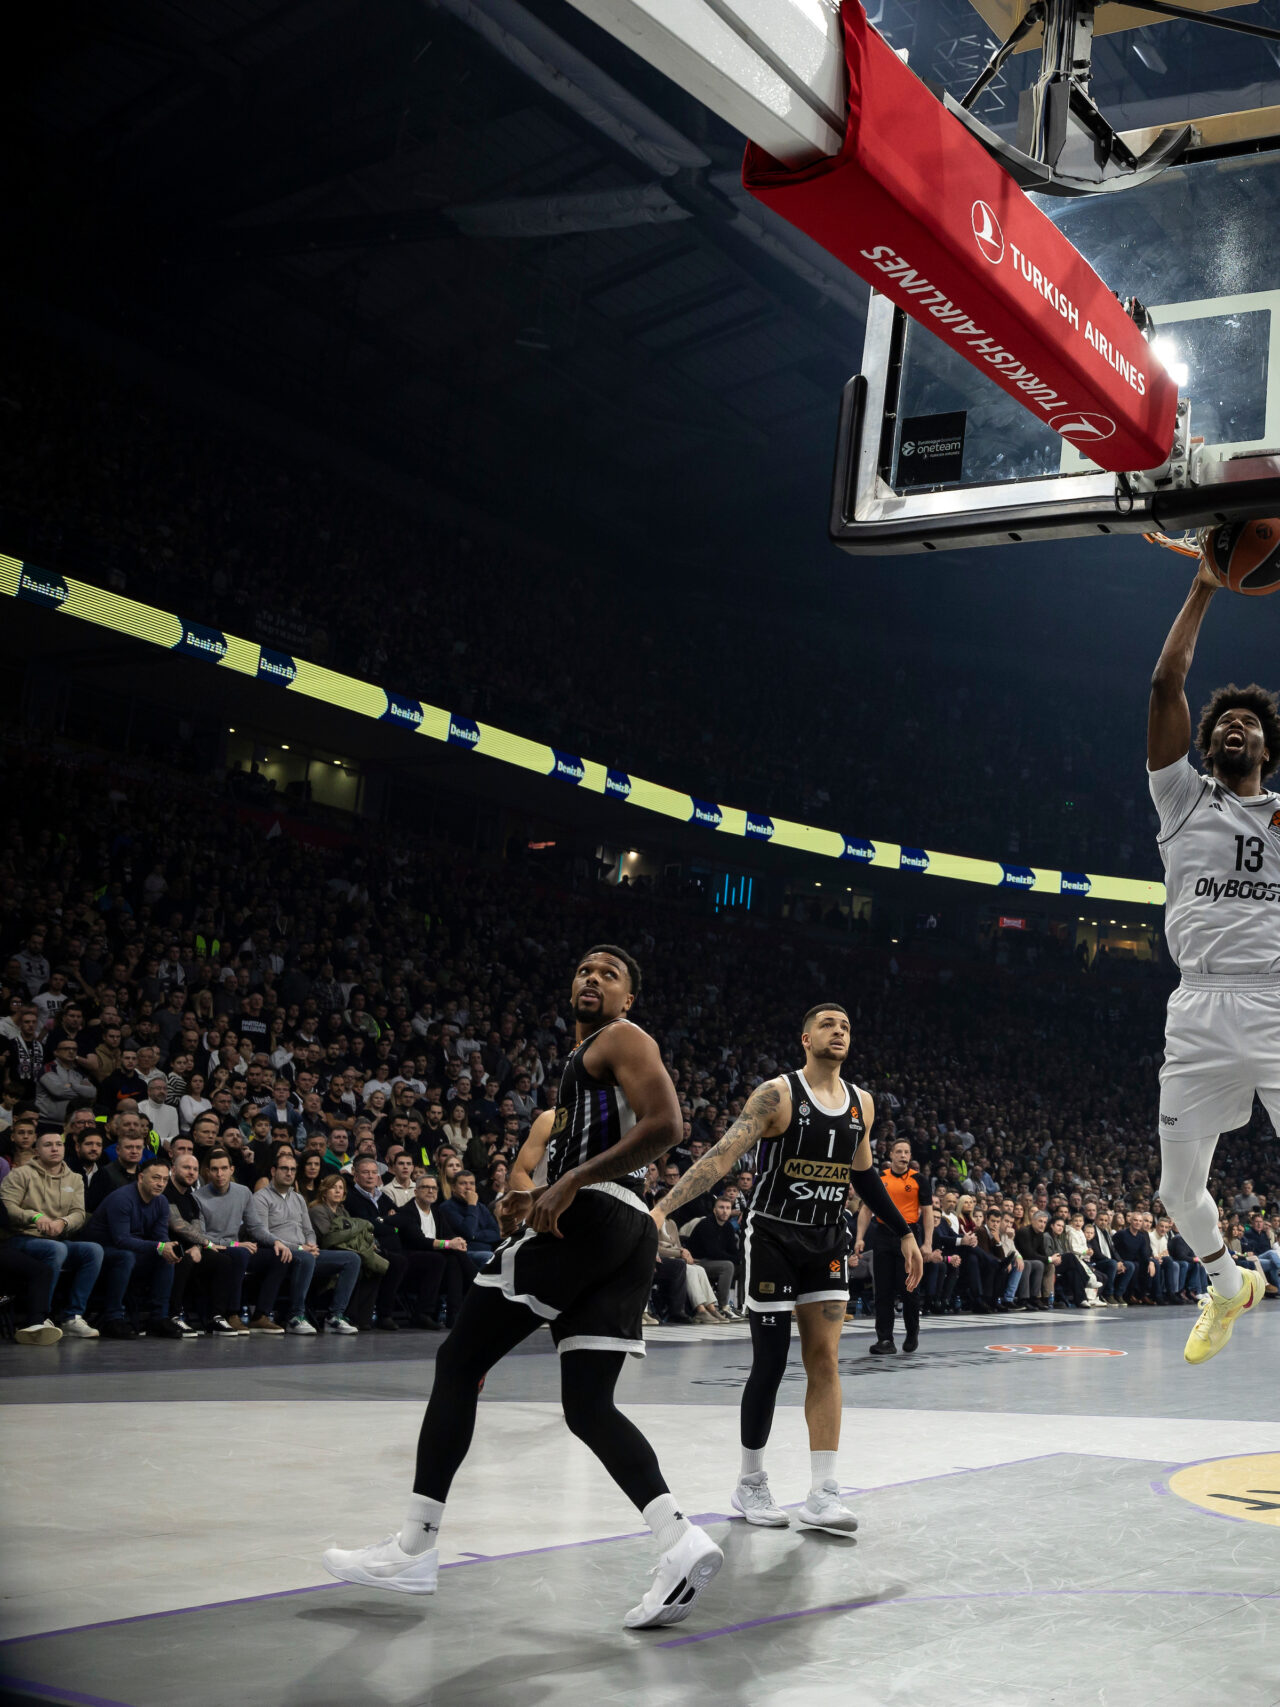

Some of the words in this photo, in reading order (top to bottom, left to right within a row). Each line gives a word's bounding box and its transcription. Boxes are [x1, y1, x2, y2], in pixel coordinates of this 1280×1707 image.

[860, 245, 985, 337] AIRLINES
[1009, 242, 1080, 331] TURKISH
[1084, 320, 1146, 396] AIRLINES
[967, 337, 1067, 412] TURKISH
[917, 441, 961, 454] oneteam
[1234, 834, 1264, 873] 13
[827, 1128, 836, 1159] 1
[814, 1185, 846, 1202] NIS
